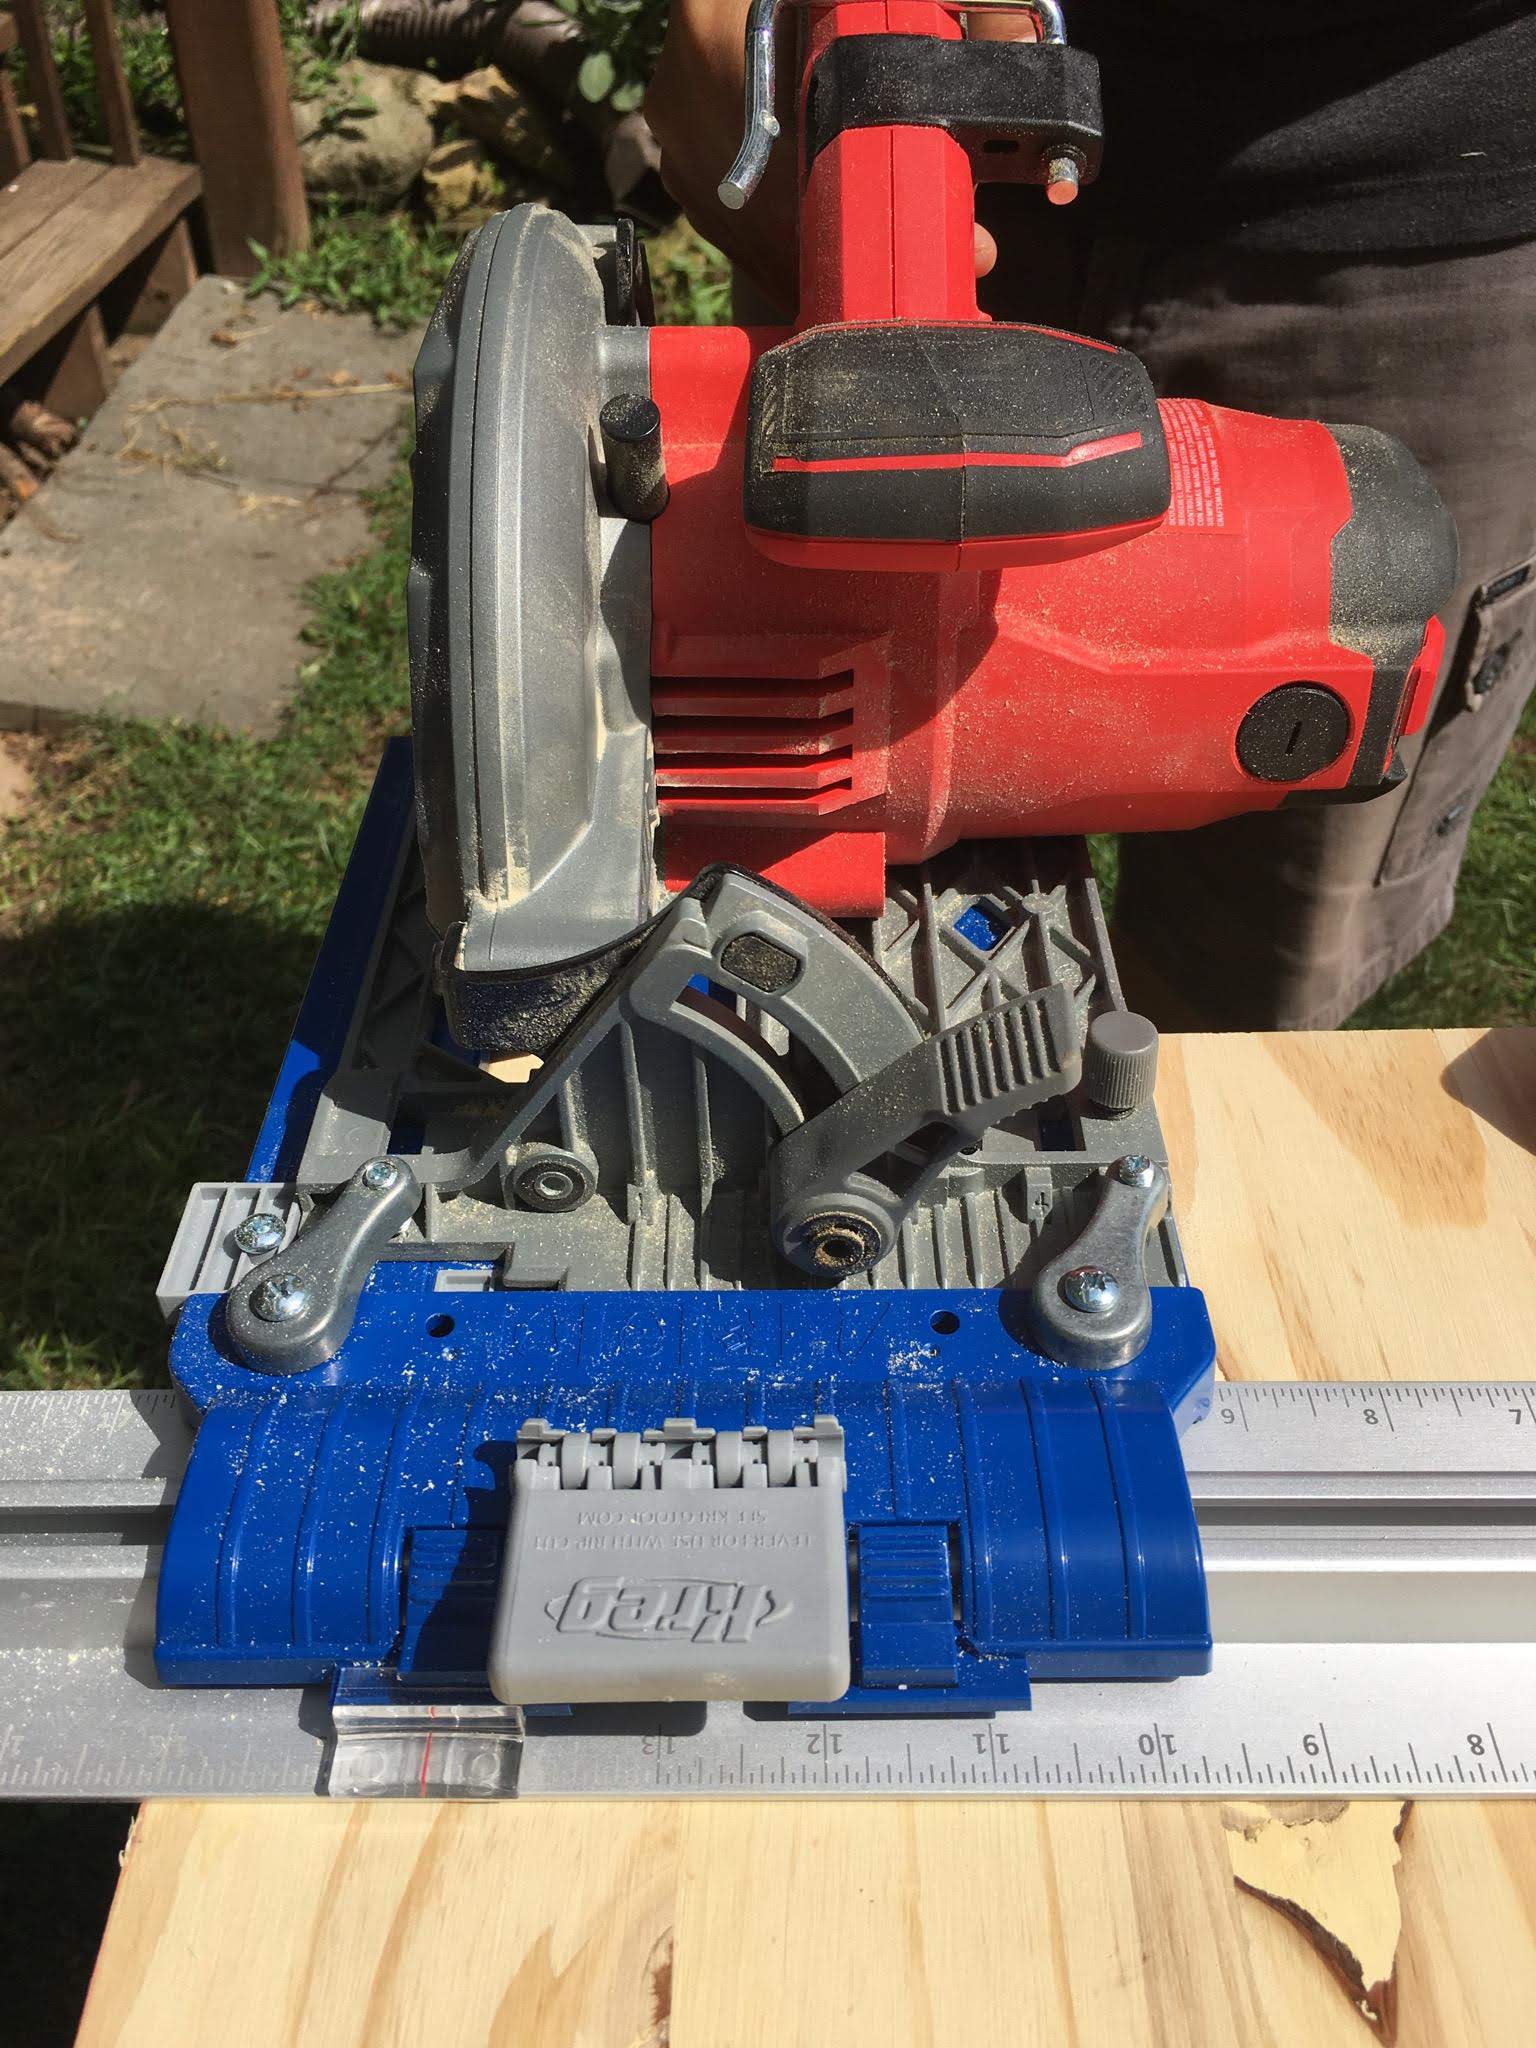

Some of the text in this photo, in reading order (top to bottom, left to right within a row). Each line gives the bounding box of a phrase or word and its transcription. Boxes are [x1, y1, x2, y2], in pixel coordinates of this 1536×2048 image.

[1221, 1408, 1235, 1424] 9
[1363, 1408, 1378, 1425] 8
[1508, 1408, 1522, 1425] 7
[557, 1576, 767, 1642] Kreg
[642, 1735, 676, 1755] 13
[807, 1733, 843, 1754] 12
[973, 1733, 1010, 1754] 11
[1138, 1733, 1177, 1755] 10
[1303, 1734, 1320, 1755] 9
[1466, 1734, 1484, 1755] 8
